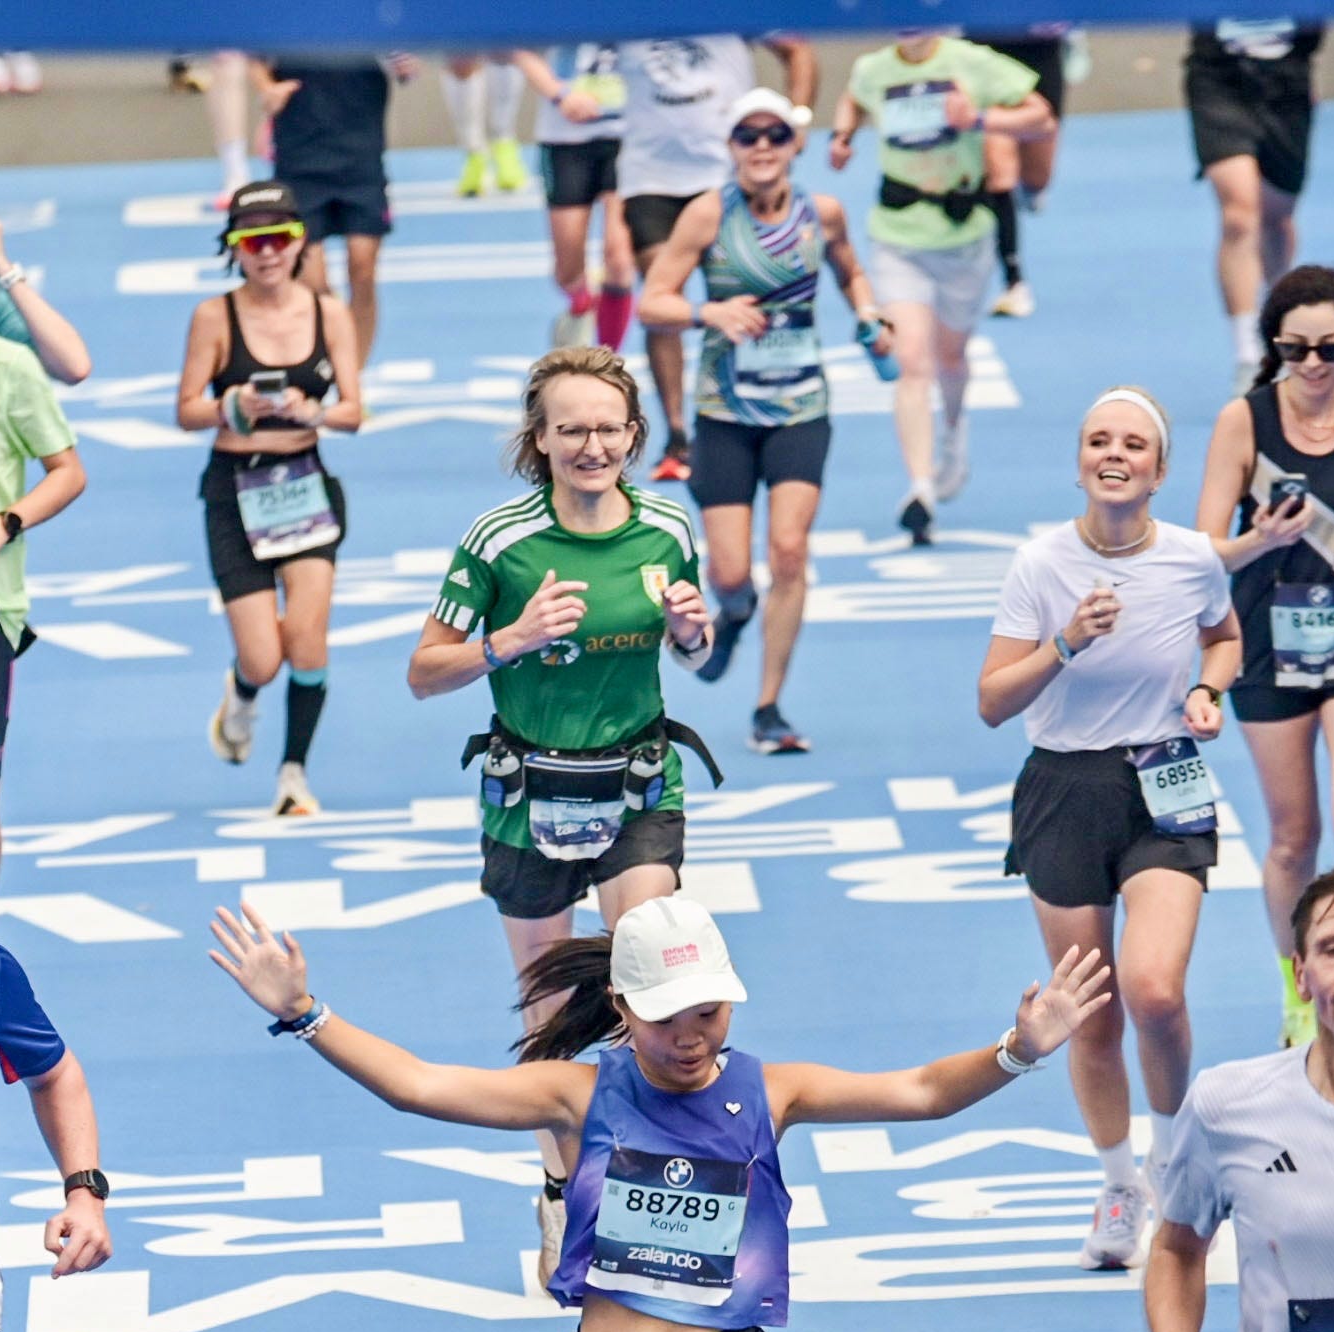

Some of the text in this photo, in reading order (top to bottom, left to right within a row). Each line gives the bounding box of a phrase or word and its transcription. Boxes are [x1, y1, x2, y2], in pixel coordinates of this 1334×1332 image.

[585, 628, 663, 653] acerc
[1156, 759, 1207, 789] 68955
[625, 1188, 720, 1222] 88789
[649, 1216, 689, 1234] Kayla
[626, 1245, 703, 1271] zalando
